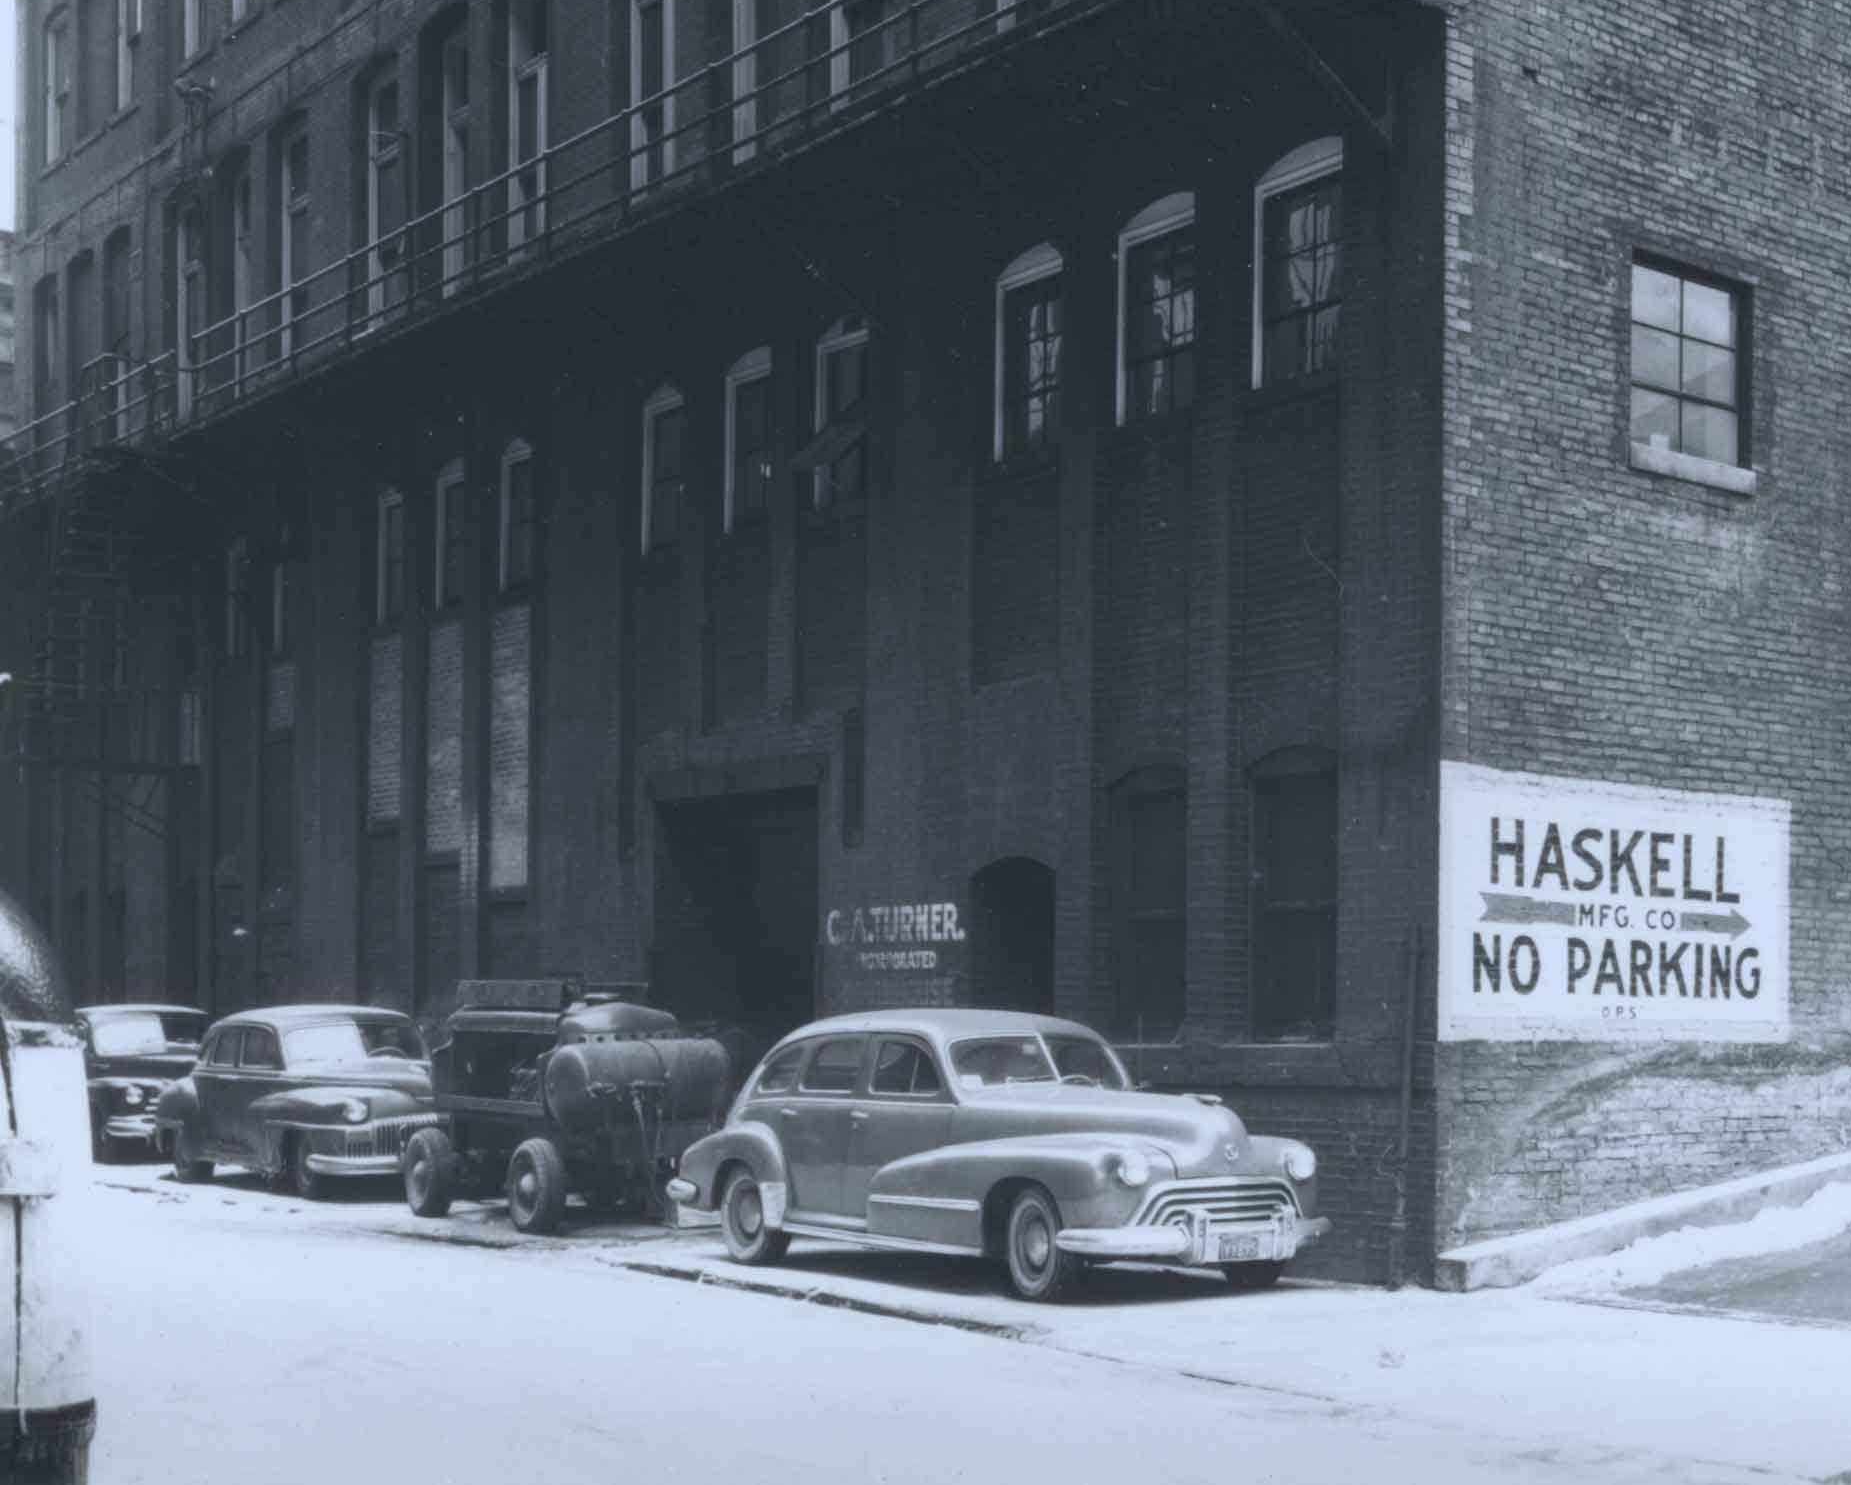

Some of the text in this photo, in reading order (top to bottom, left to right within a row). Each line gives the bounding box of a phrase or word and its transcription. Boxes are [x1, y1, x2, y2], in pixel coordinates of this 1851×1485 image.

[1490, 817, 1741, 904] HASKELL
[1472, 932, 1762, 999] NO PARKING
